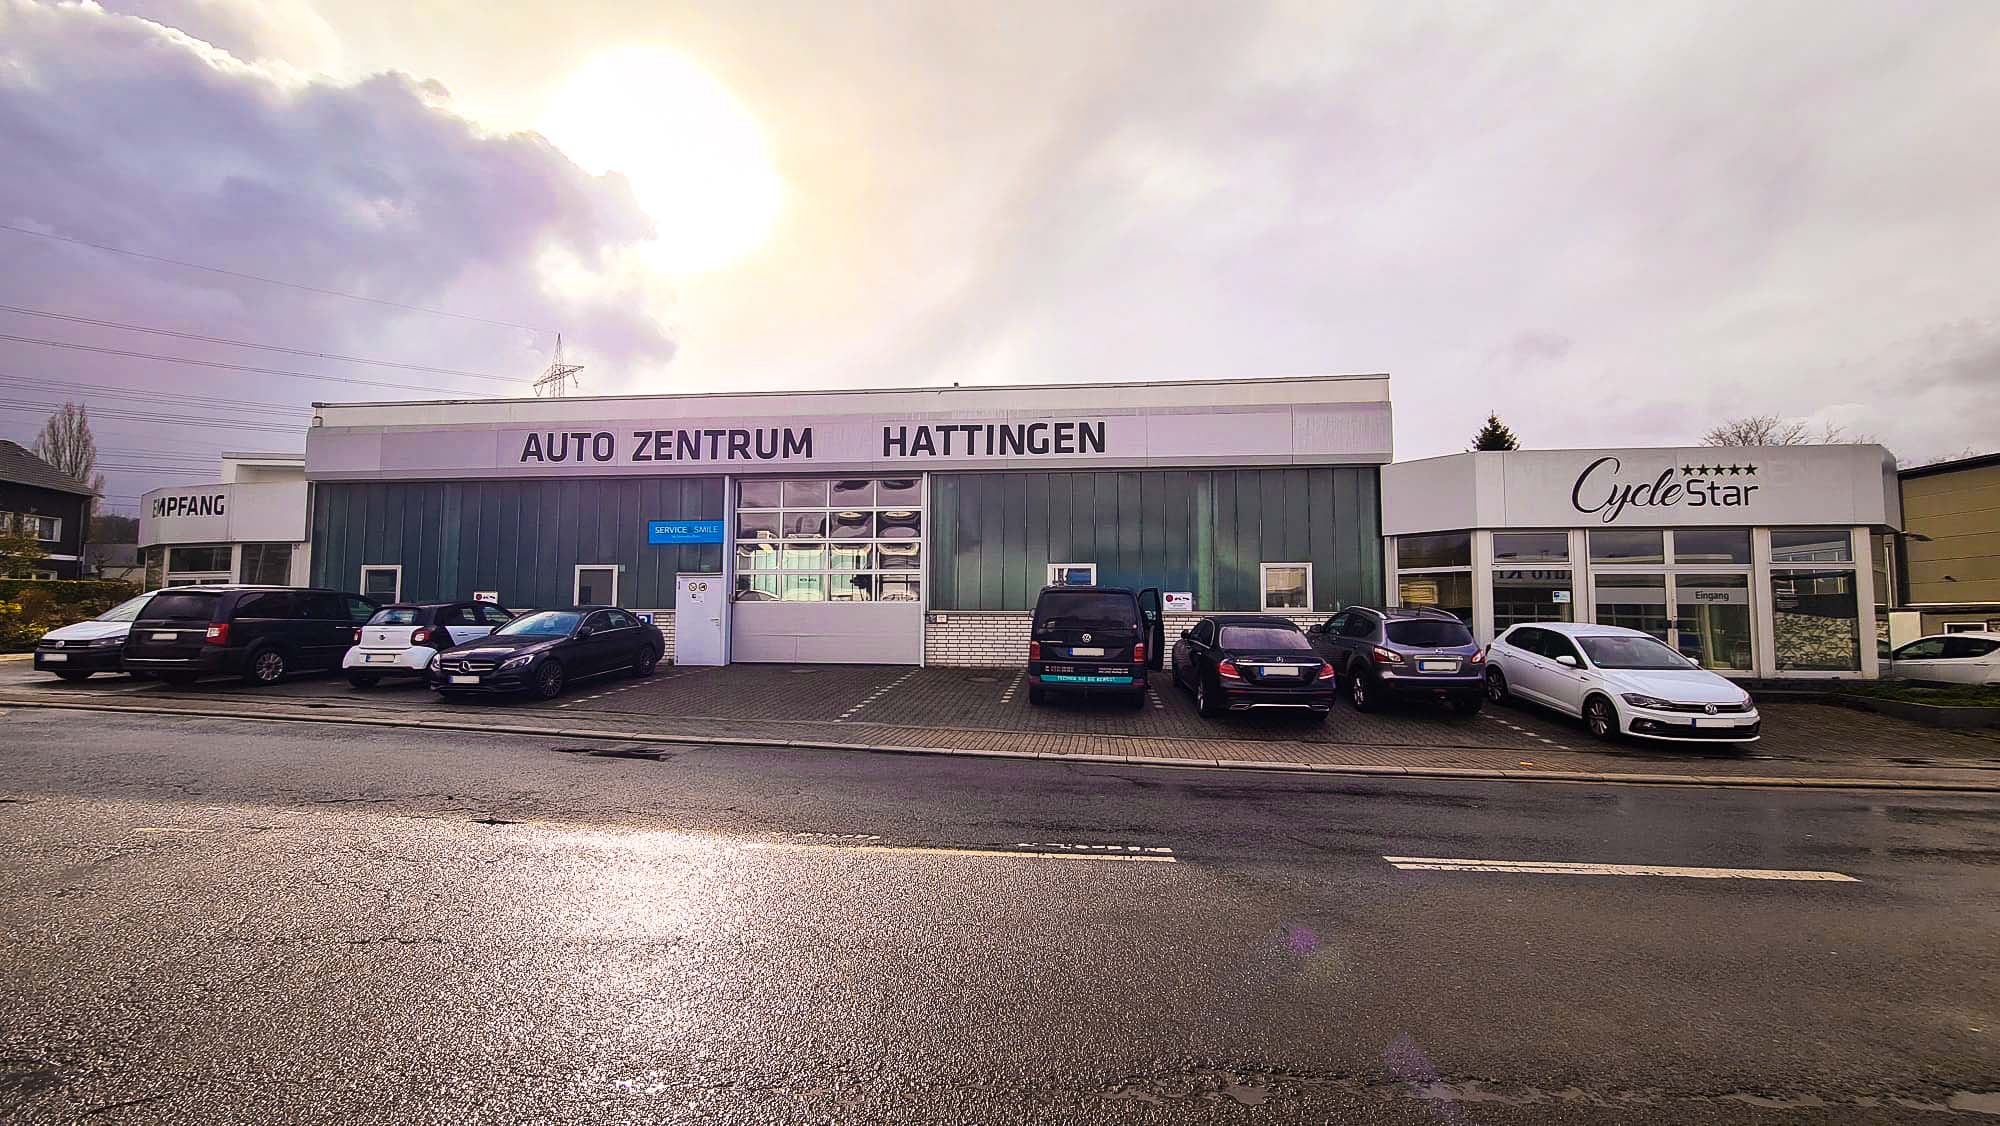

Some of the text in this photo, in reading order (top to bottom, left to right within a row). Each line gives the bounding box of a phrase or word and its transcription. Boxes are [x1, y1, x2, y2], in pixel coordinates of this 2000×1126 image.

[520, 422, 1105, 462] AUTO ZENTRUM HATTINGEN
[1571, 457, 1758, 523] Cycle Star
[152, 494, 225, 518] EMPFANG
[655, 526, 687, 534] SERVICE
[1695, 590, 1729, 602] Eingang
